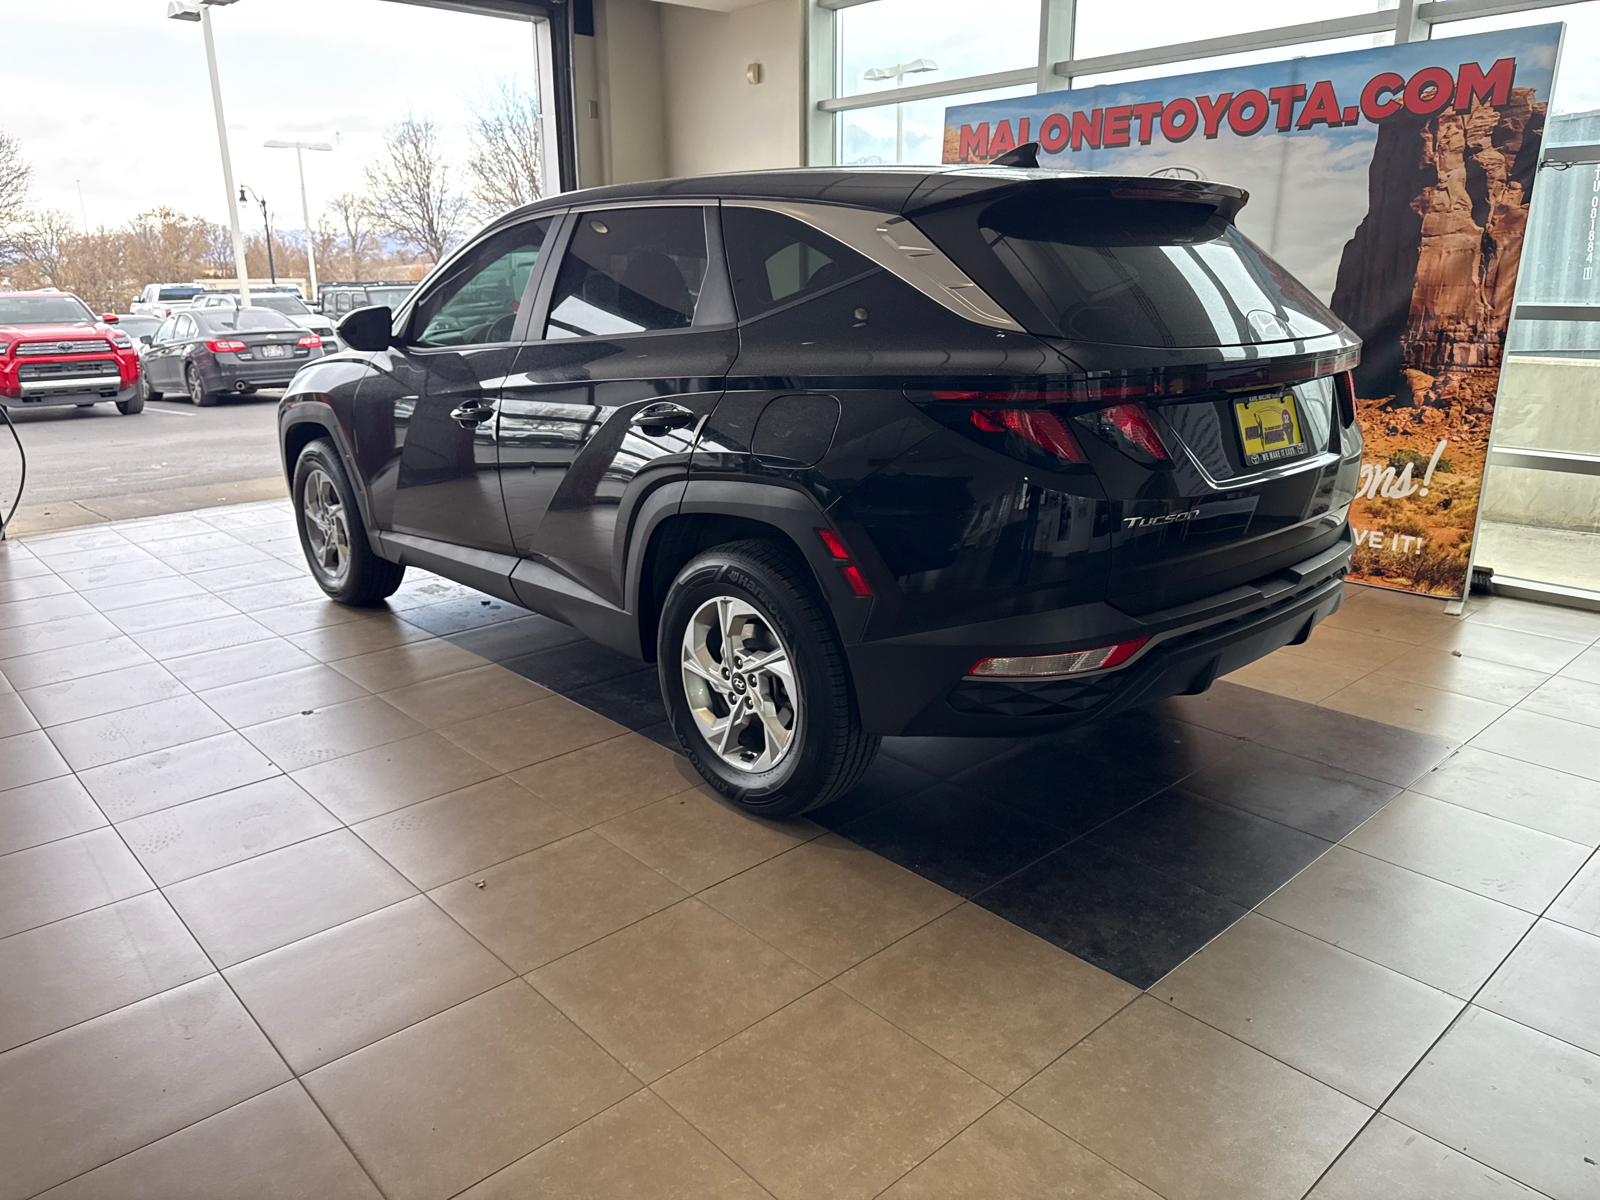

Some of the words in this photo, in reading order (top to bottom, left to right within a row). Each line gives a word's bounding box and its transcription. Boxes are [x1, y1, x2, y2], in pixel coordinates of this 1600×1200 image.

[1592, 164, 1600, 192] TU
[1586, 196, 1599, 263] 081884
[1392, 534, 1423, 555] IT!
